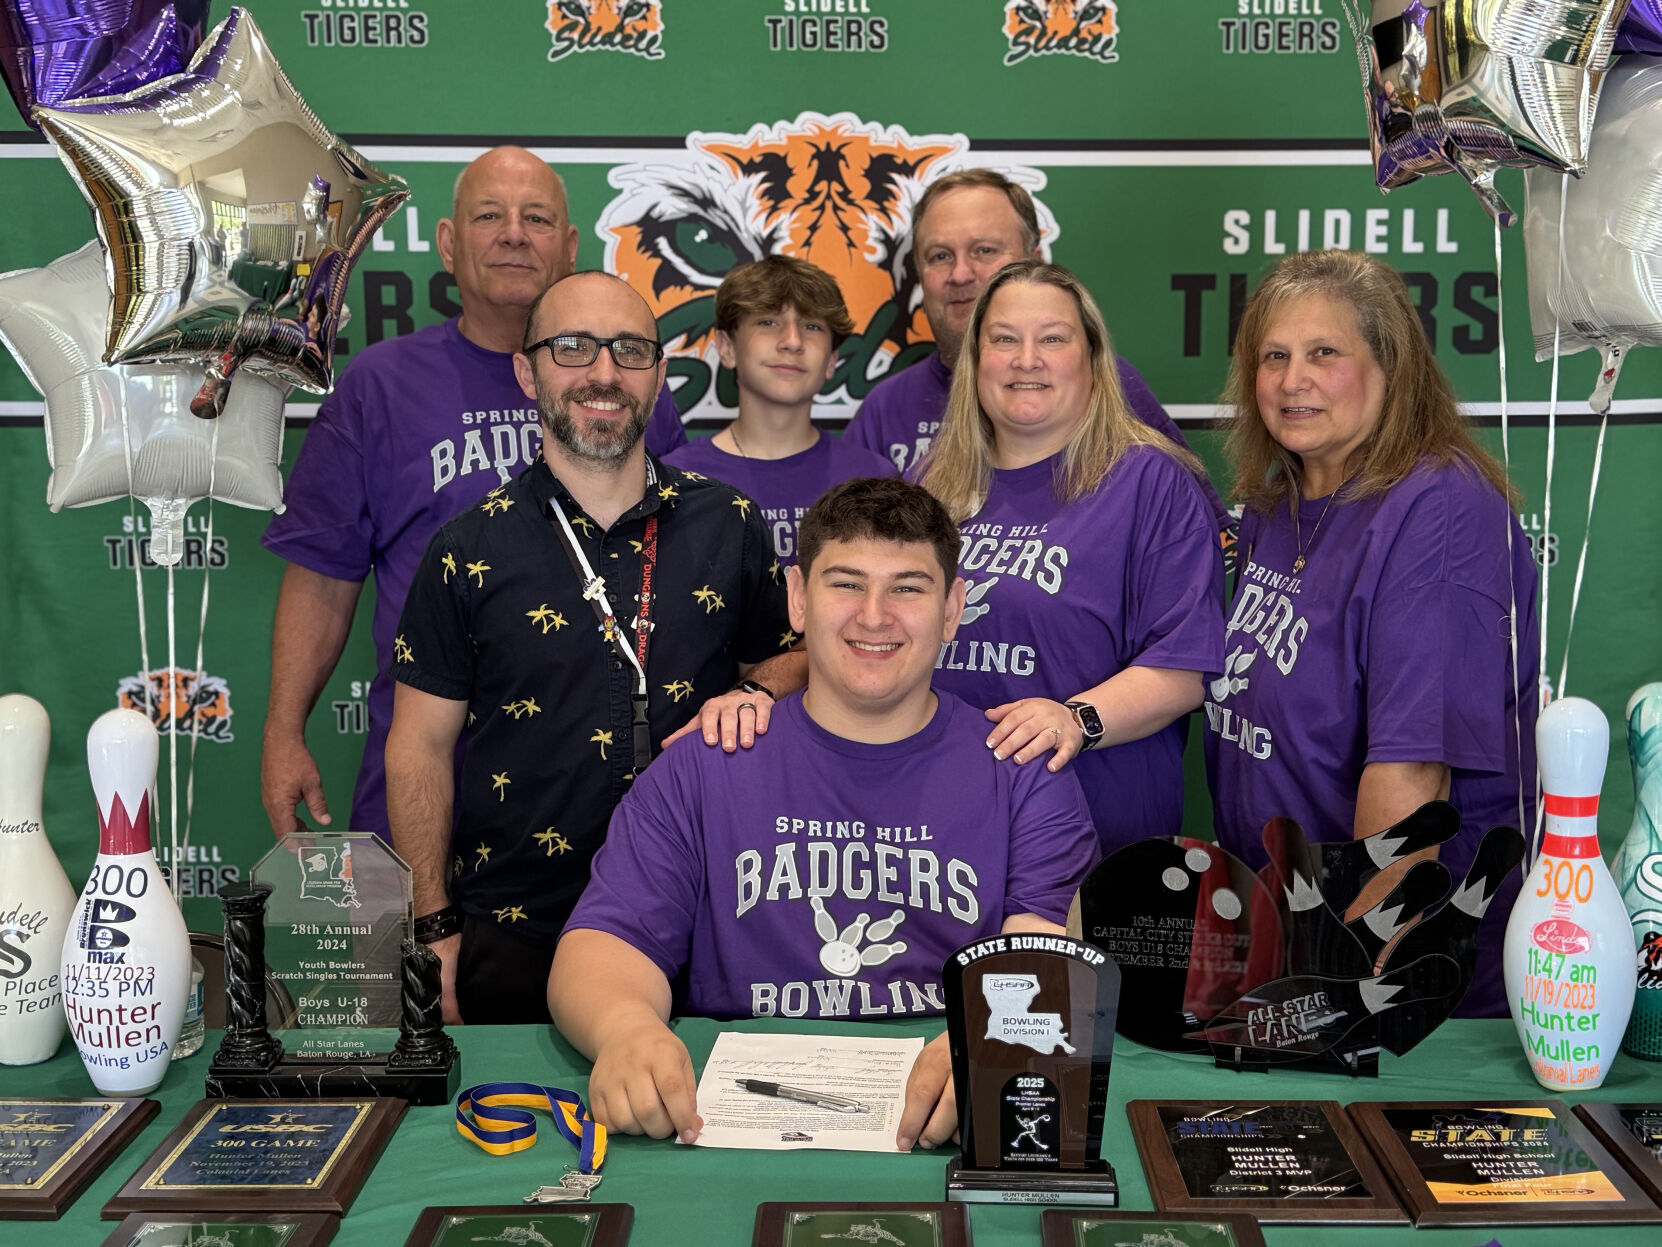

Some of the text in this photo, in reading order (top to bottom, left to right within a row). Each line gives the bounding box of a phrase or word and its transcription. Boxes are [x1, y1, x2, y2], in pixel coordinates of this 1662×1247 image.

[301, 11, 428, 47] TIGERS
[547, 22, 665, 61] Slidell
[764, 16, 889, 52] TIGERS
[1218, 18, 1341, 54] TIGERS
[1004, 26, 1119, 65] Slidell
[1222, 208, 1458, 255] SLIDELL
[461, 409, 539, 425] SPRING
[430, 423, 544, 493] BADG
[1008, 523, 1048, 537] HILL
[1243, 561, 1290, 589] PRING
[1226, 583, 1309, 676] DGERS
[935, 640, 1036, 676] LING
[0, 819, 40, 834] unter
[775, 816, 933, 842] SPRING HILL
[85, 864, 148, 898] 300
[735, 841, 979, 925] BADGERS
[1536, 858, 1594, 904] 300
[291, 924, 372, 935] 28th Annual
[87, 951, 126, 964] max
[317, 939, 347, 950] 2024
[956, 936, 1105, 967] STATE RUNNER-UP
[65, 963, 155, 983] 11/11/2023
[271, 972, 393, 981] Scratch Singles Tournament
[299, 961, 366, 969] Youth Bowlers
[1528, 947, 1597, 984] 11:47 am
[4, 974, 59, 996] Place
[65, 975, 153, 998] 12:35 PM
[751, 979, 946, 1018] BOWLIN
[1524, 975, 1596, 1010] 11/19/2023
[65, 993, 161, 1026] Hunter
[299, 997, 368, 1009] Boys U-18
[1520, 996, 1600, 1032] Hunter
[69, 1019, 160, 1048] Mullen
[297, 1014, 369, 1025] CHAMPION
[1002, 1017, 1050, 1026] BOWLING
[79, 1041, 169, 1069] owling USA
[297, 1050, 323, 1058] Baton
[1525, 1029, 1600, 1062] Mullen
[1017, 1077, 1045, 1088] 2025
[1177, 1122, 1261, 1134] STATE
[1410, 1129, 1548, 1142] STATE
[210, 1140, 321, 1148] 300 GAME
